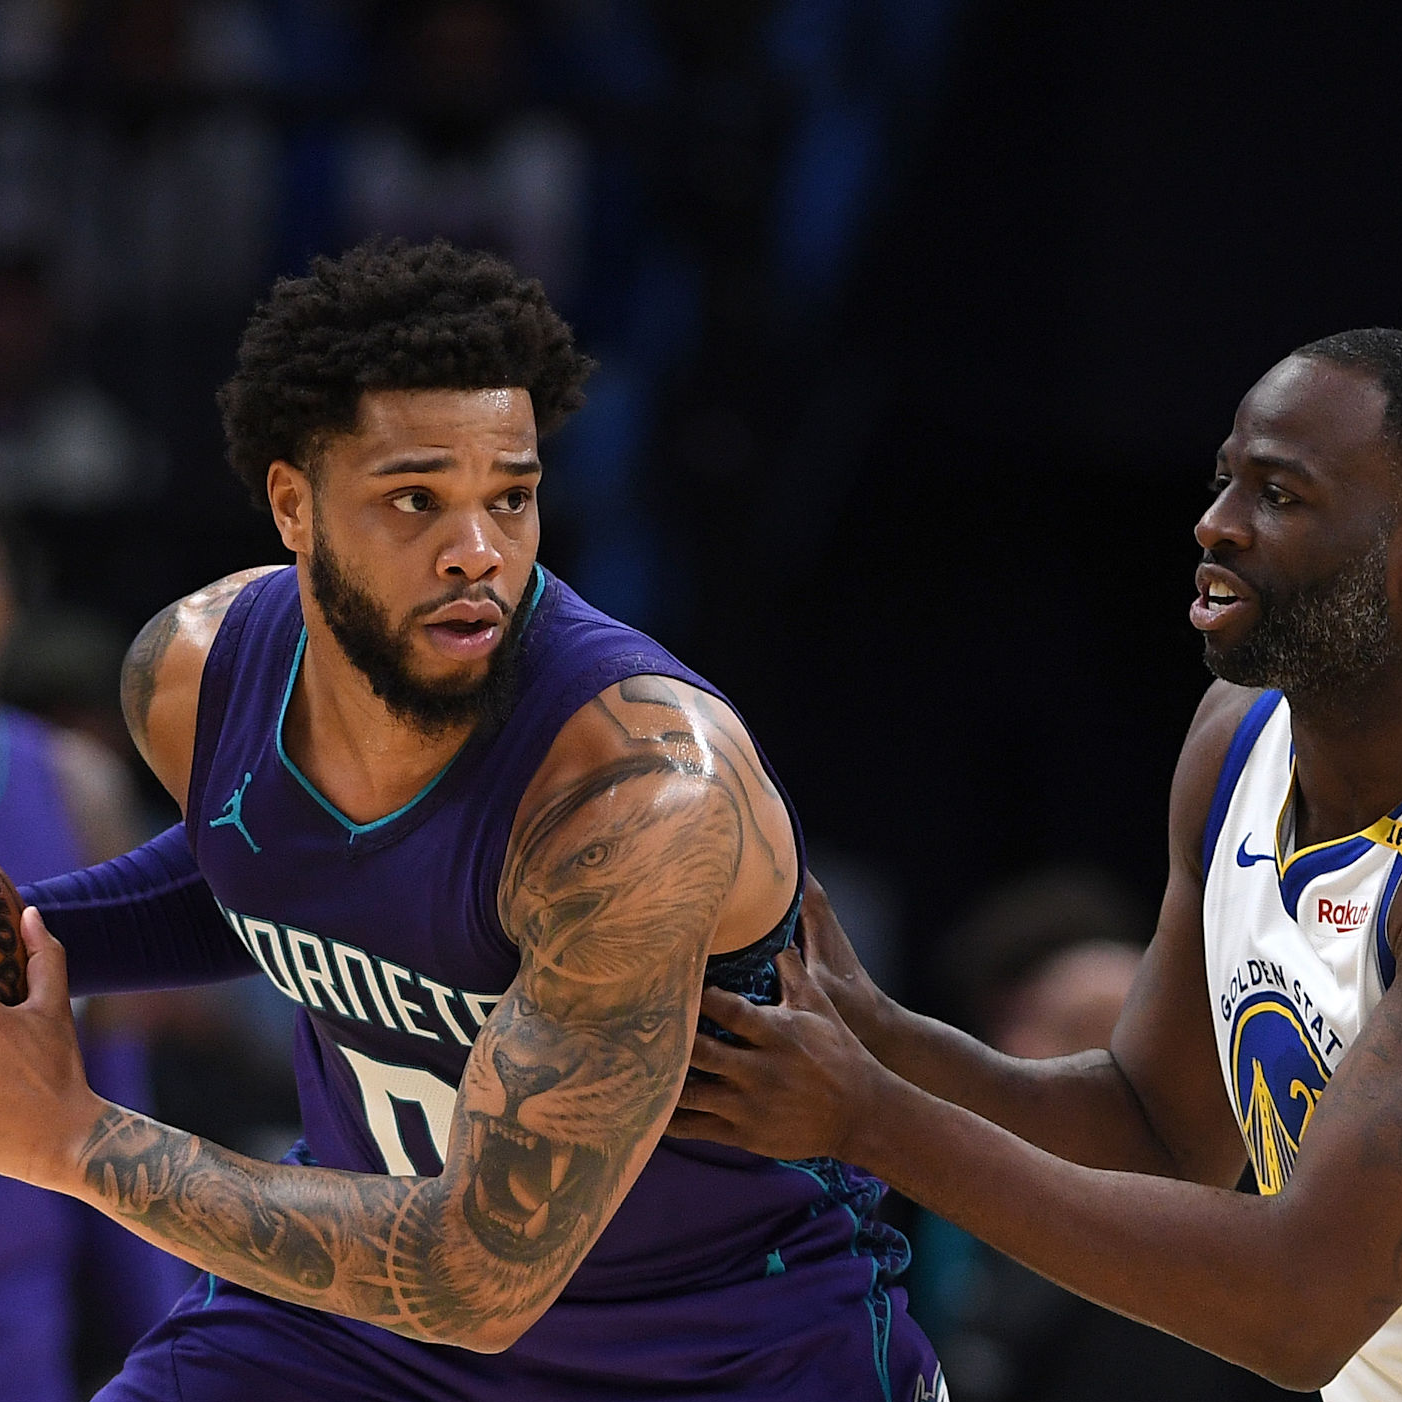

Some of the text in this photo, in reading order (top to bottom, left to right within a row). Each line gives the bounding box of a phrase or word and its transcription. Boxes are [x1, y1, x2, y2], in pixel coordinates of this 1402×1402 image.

[224, 908, 503, 1047] ORNET
[1220, 959, 1343, 1057] GOLDEN STAT
